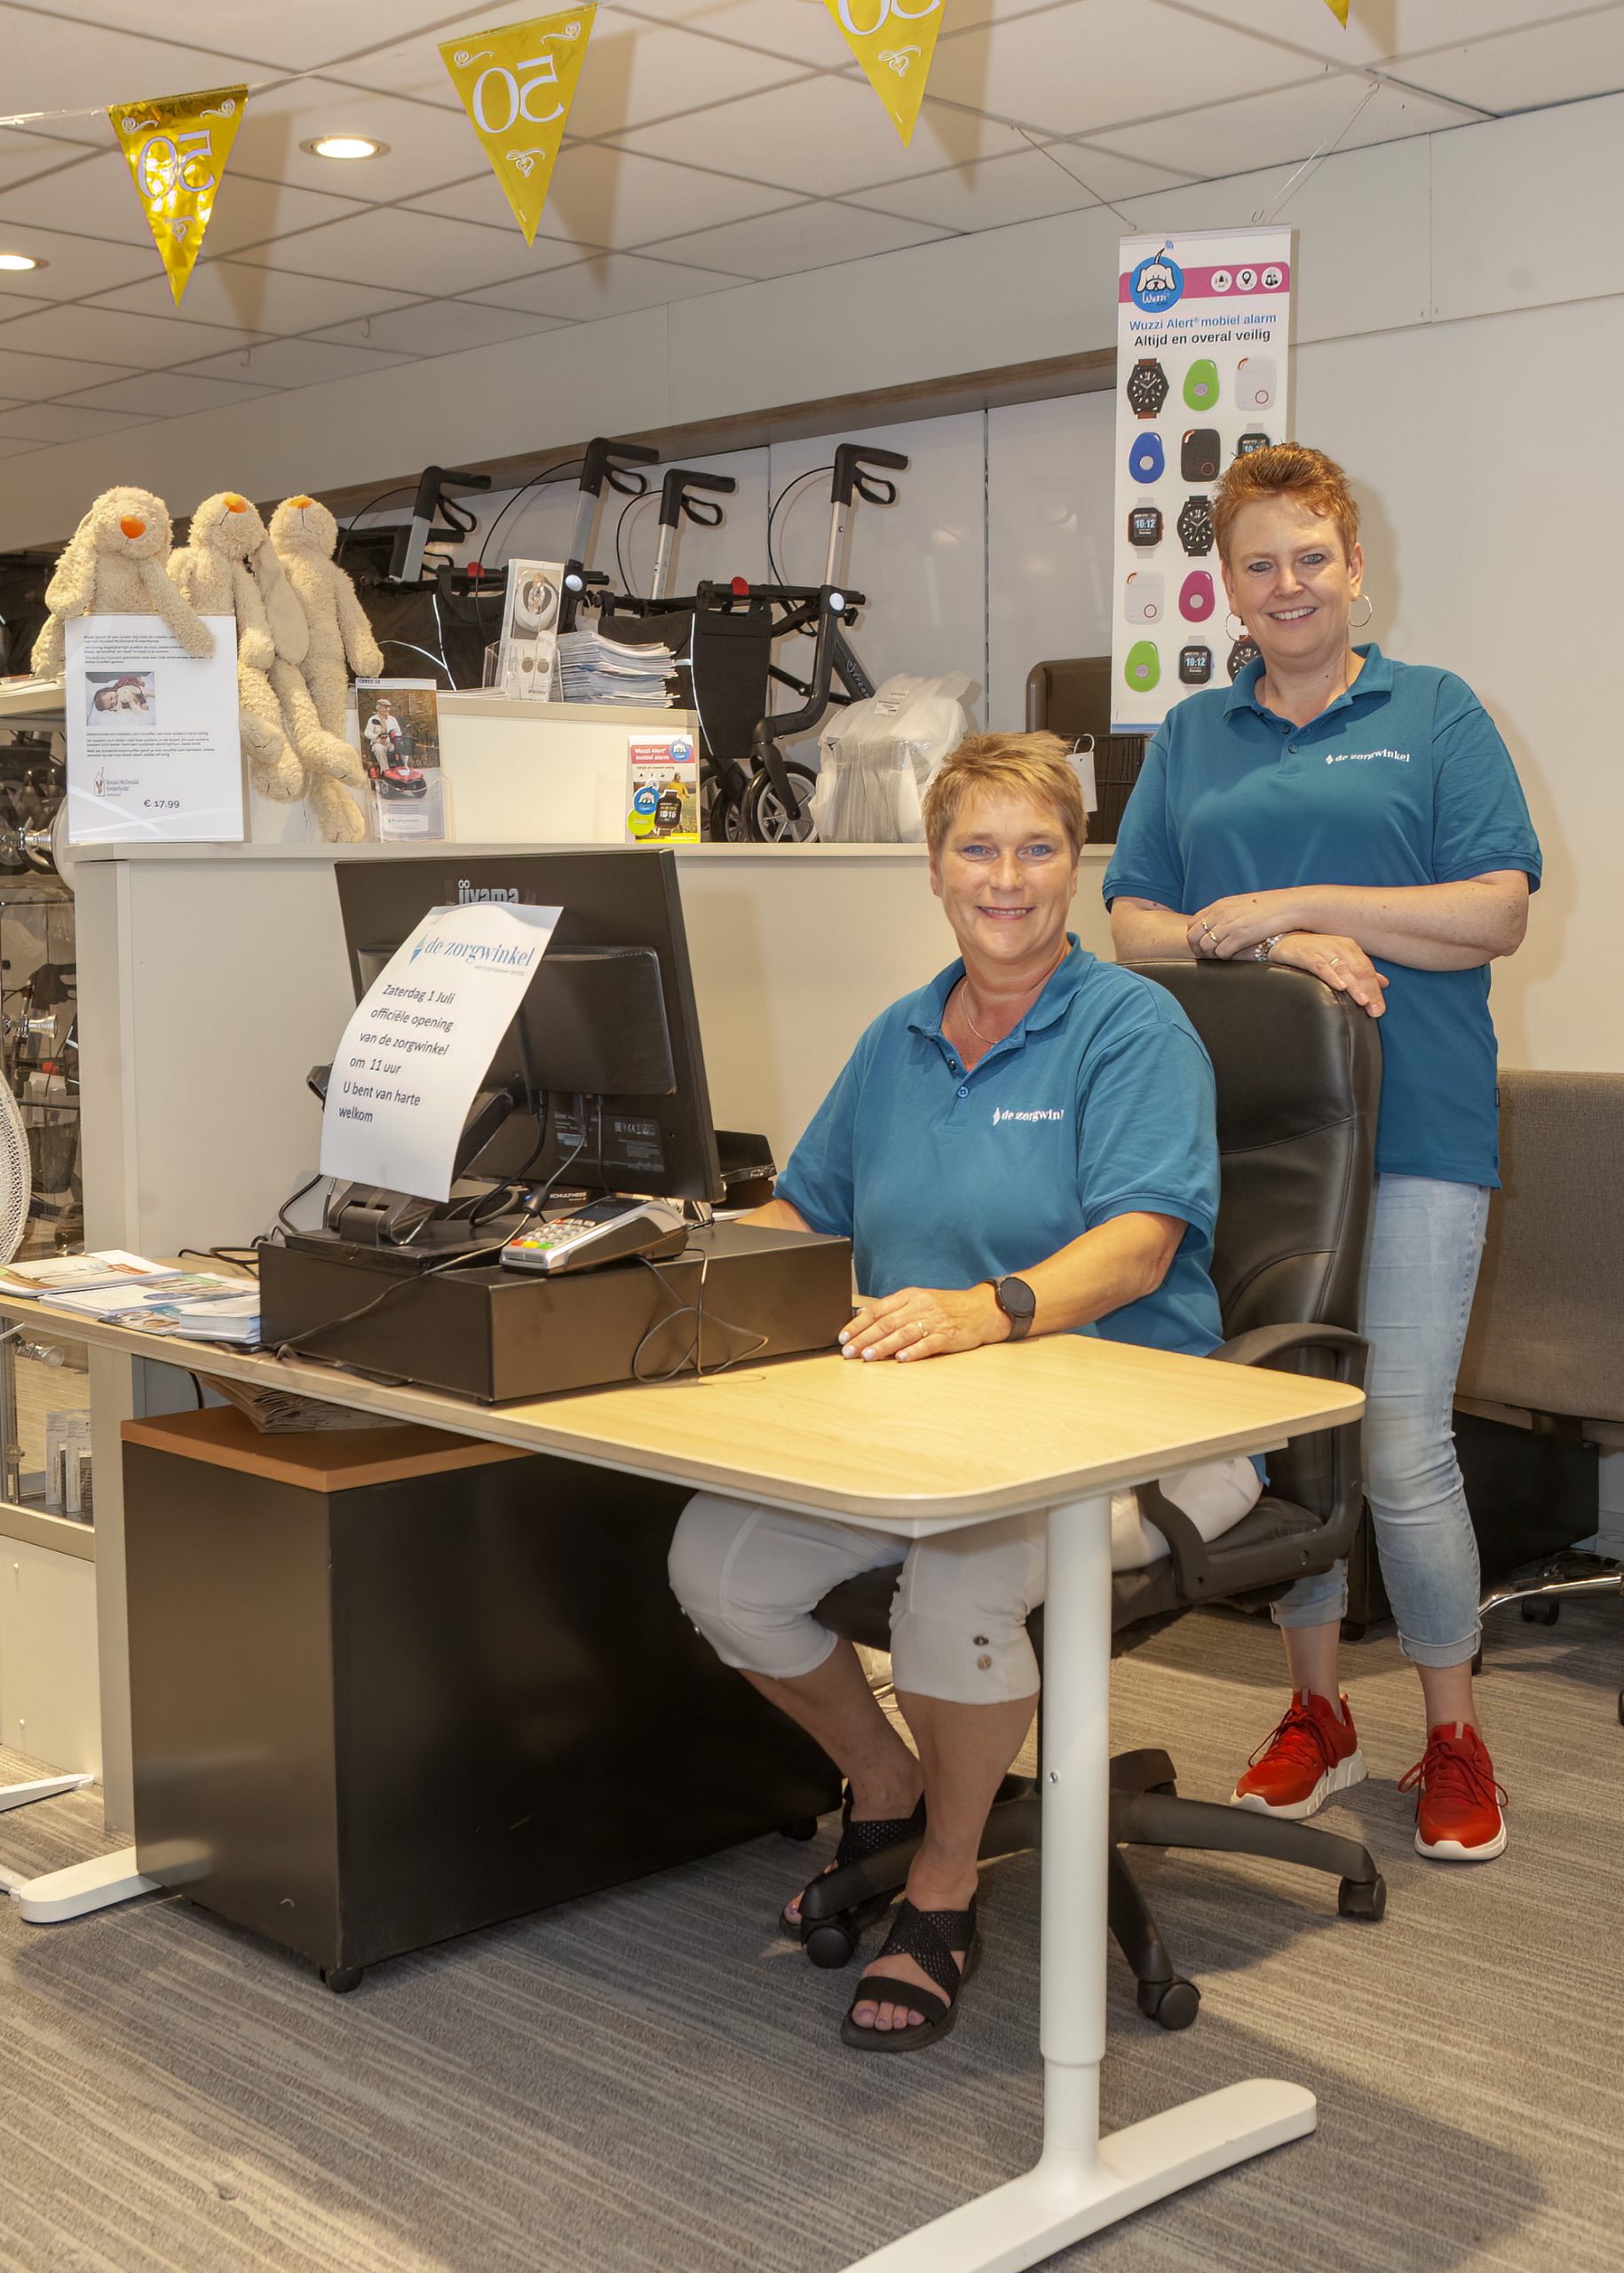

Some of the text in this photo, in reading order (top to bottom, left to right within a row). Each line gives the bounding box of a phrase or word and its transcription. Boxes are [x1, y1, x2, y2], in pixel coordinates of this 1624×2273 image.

[1129, 319, 1163, 331] Wuzzi
[1201, 314, 1240, 327] mobiel
[1243, 313, 1277, 325] alarm
[1134, 329, 1271, 348] Altijd en overal veilig
[1136, 519, 1155, 528] 10:12
[1185, 657, 1206, 667] 10:12
[424, 937, 535, 967] de zorgwinkel
[382, 984, 456, 1004] Zaterdag 1 Juli
[370, 1008, 454, 1033] officiële opening
[360, 1032, 450, 1056] van de zorgwinkel
[349, 1057, 401, 1073] om 11 uur
[343, 1081, 421, 1105] U bent van harte
[338, 1106, 374, 1122] welkom
[1001, 1109, 1065, 1122] de zorgwin
